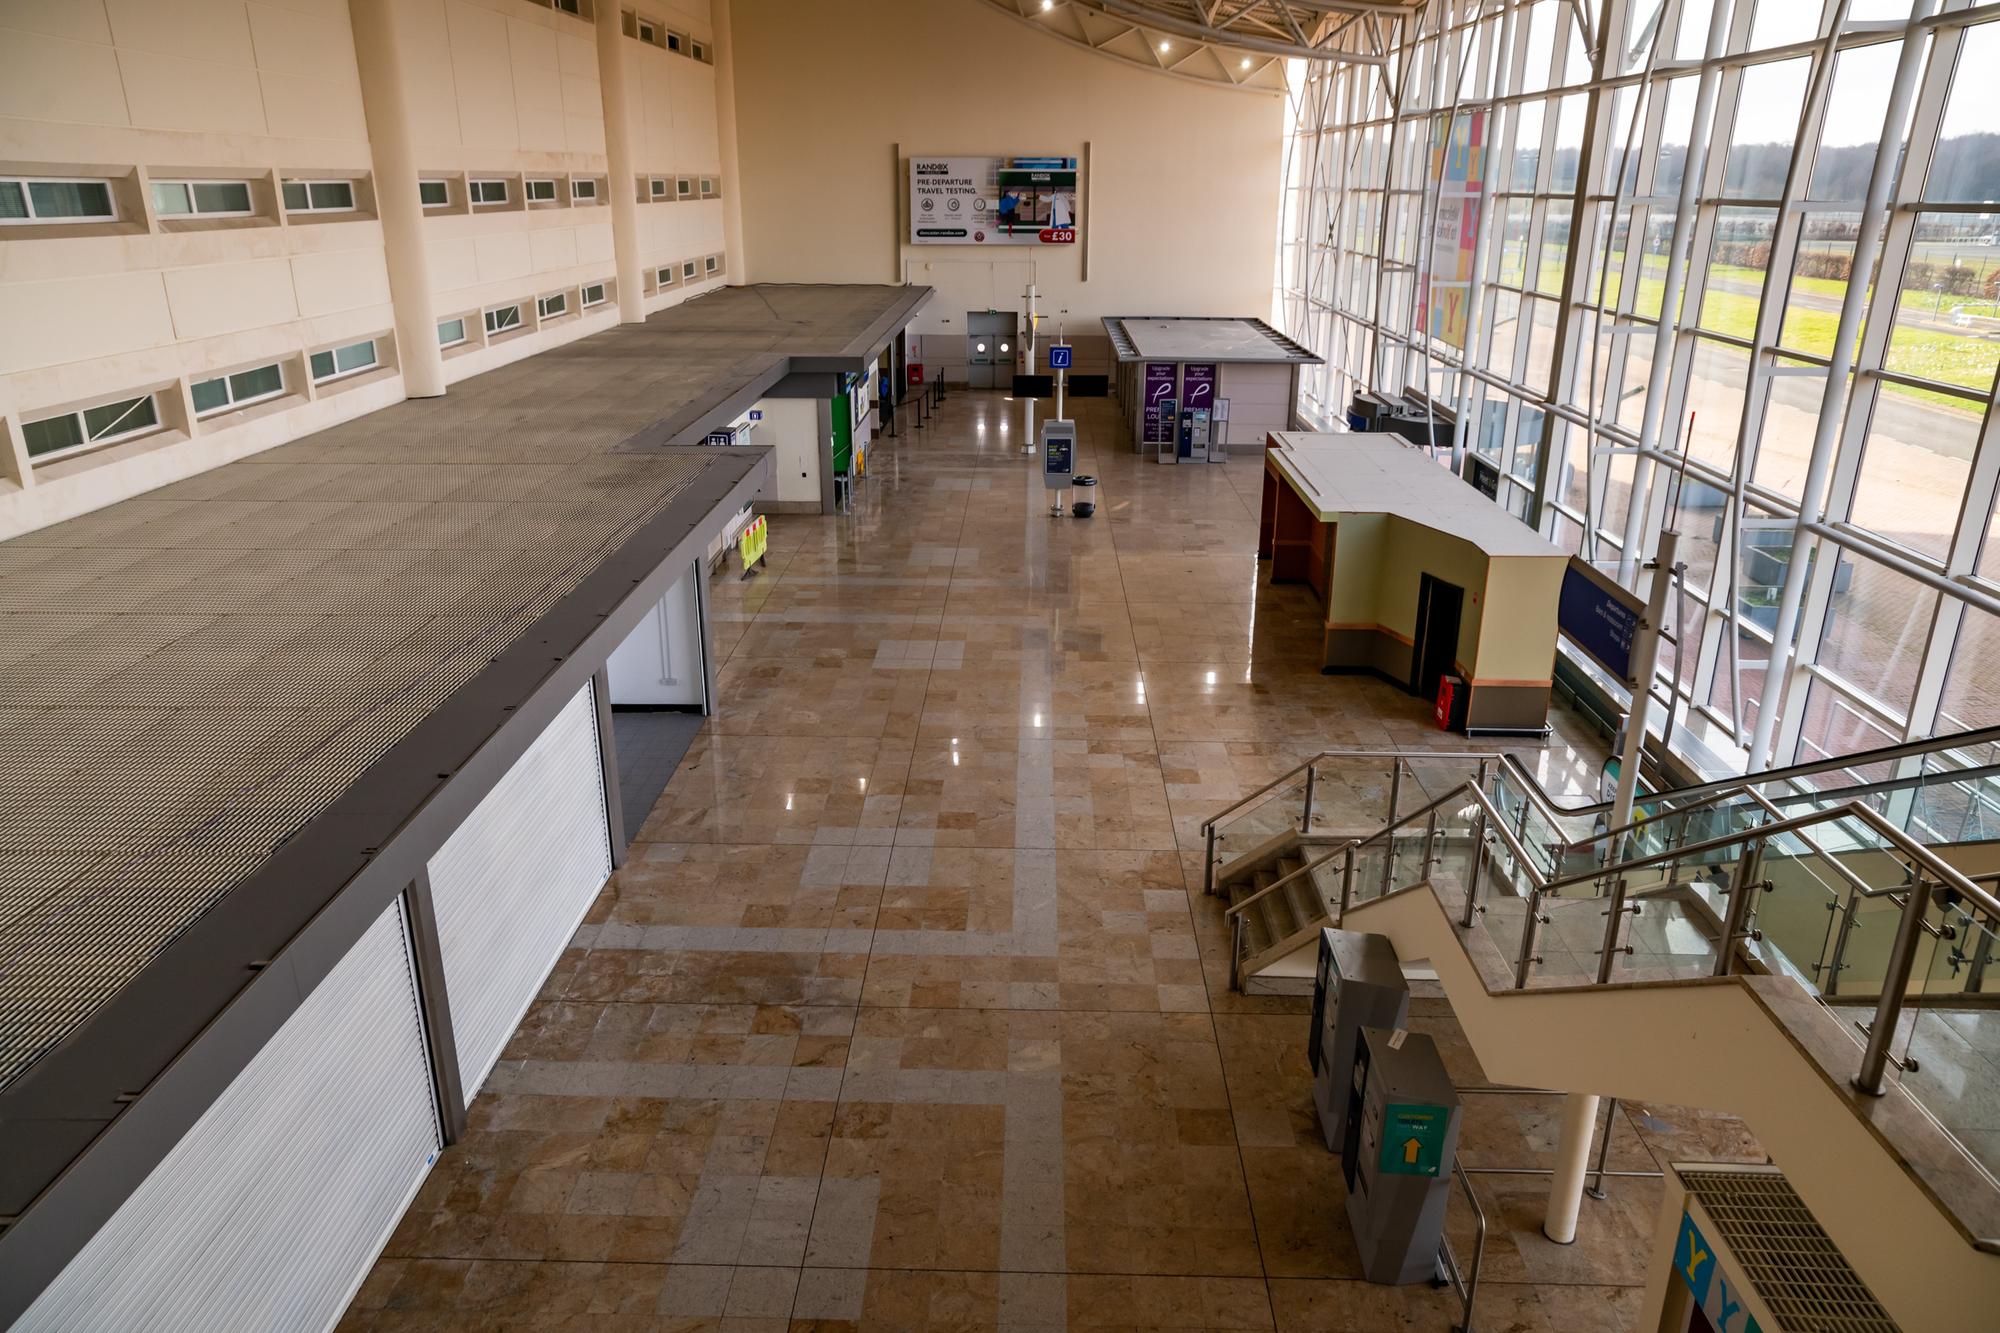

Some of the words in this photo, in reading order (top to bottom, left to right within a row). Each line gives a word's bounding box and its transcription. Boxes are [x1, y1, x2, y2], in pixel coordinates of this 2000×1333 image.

[916, 163, 949, 171] RANDOX
[917, 187, 944, 195] TRAVEL
[946, 187, 978, 195] TESTING.
[1052, 231, 1072, 241] £30
[1687, 1229, 1708, 1282] Y
